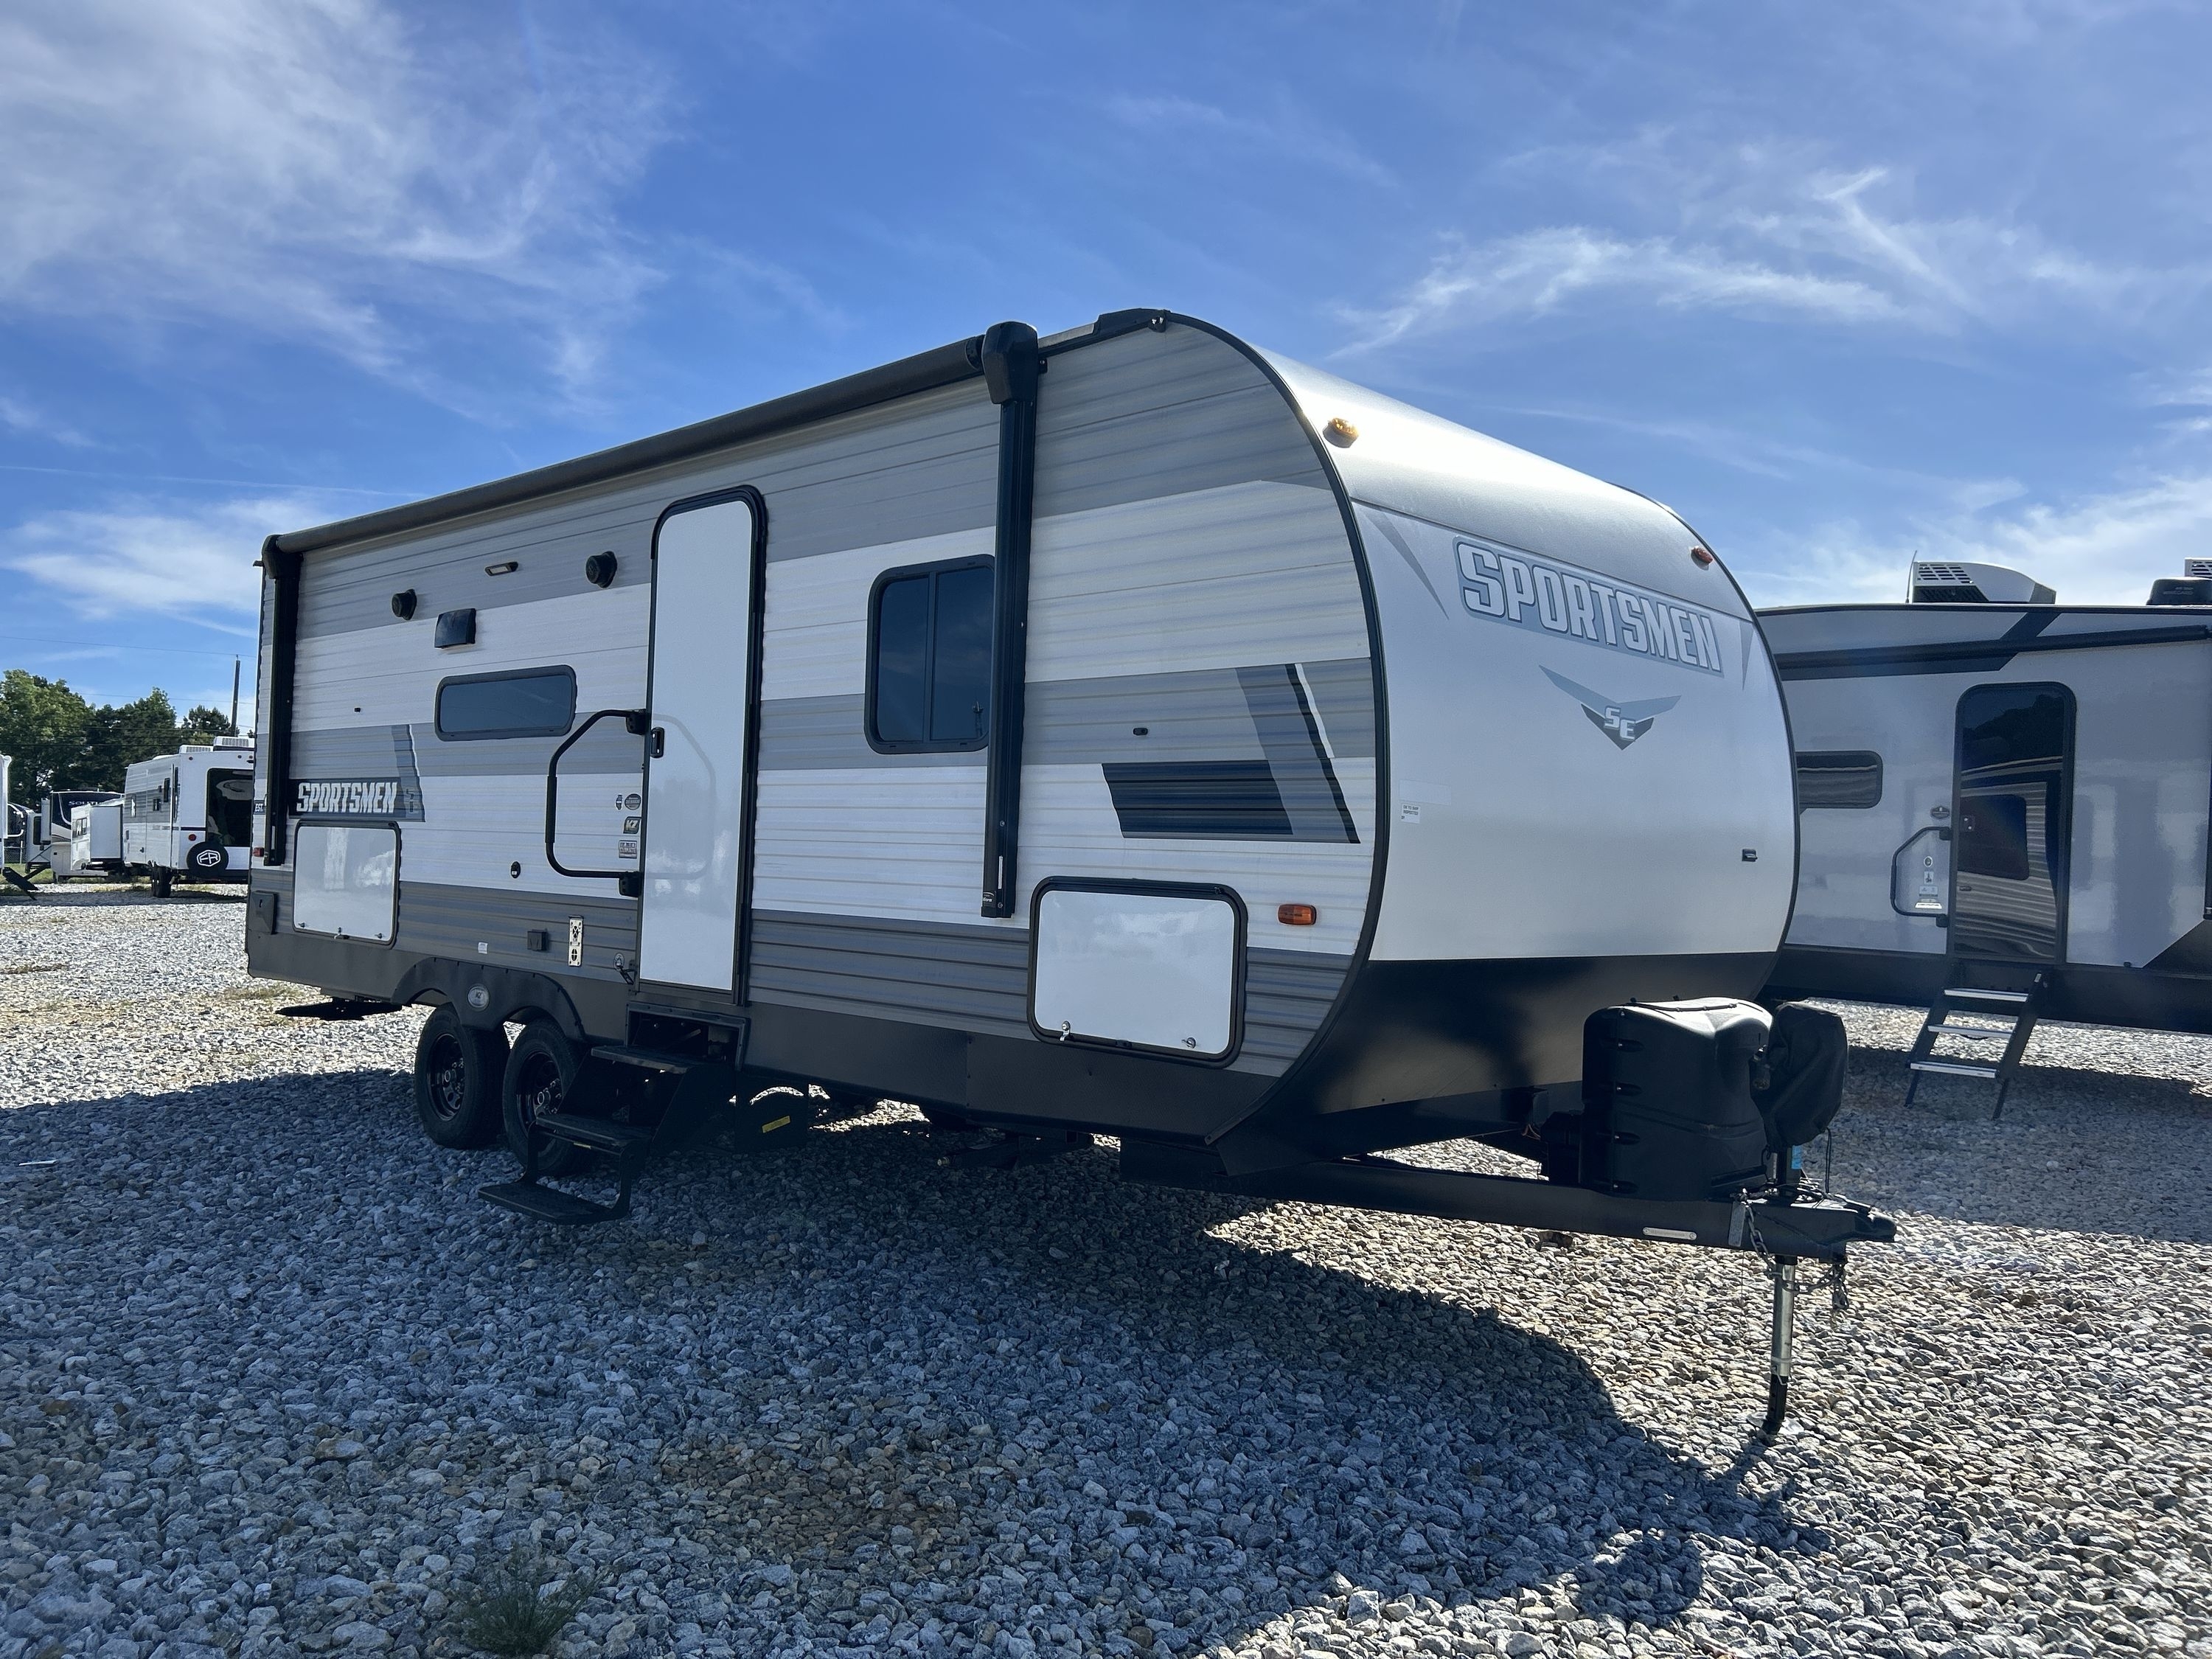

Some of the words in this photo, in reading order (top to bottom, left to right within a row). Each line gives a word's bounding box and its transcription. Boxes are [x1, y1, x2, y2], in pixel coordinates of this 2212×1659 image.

[1458, 541, 1722, 672] SPORTSMEN
[1604, 706, 1635, 741] SE
[296, 782, 397, 813] SPORTSMEN
[626, 819, 639, 830] KZ
